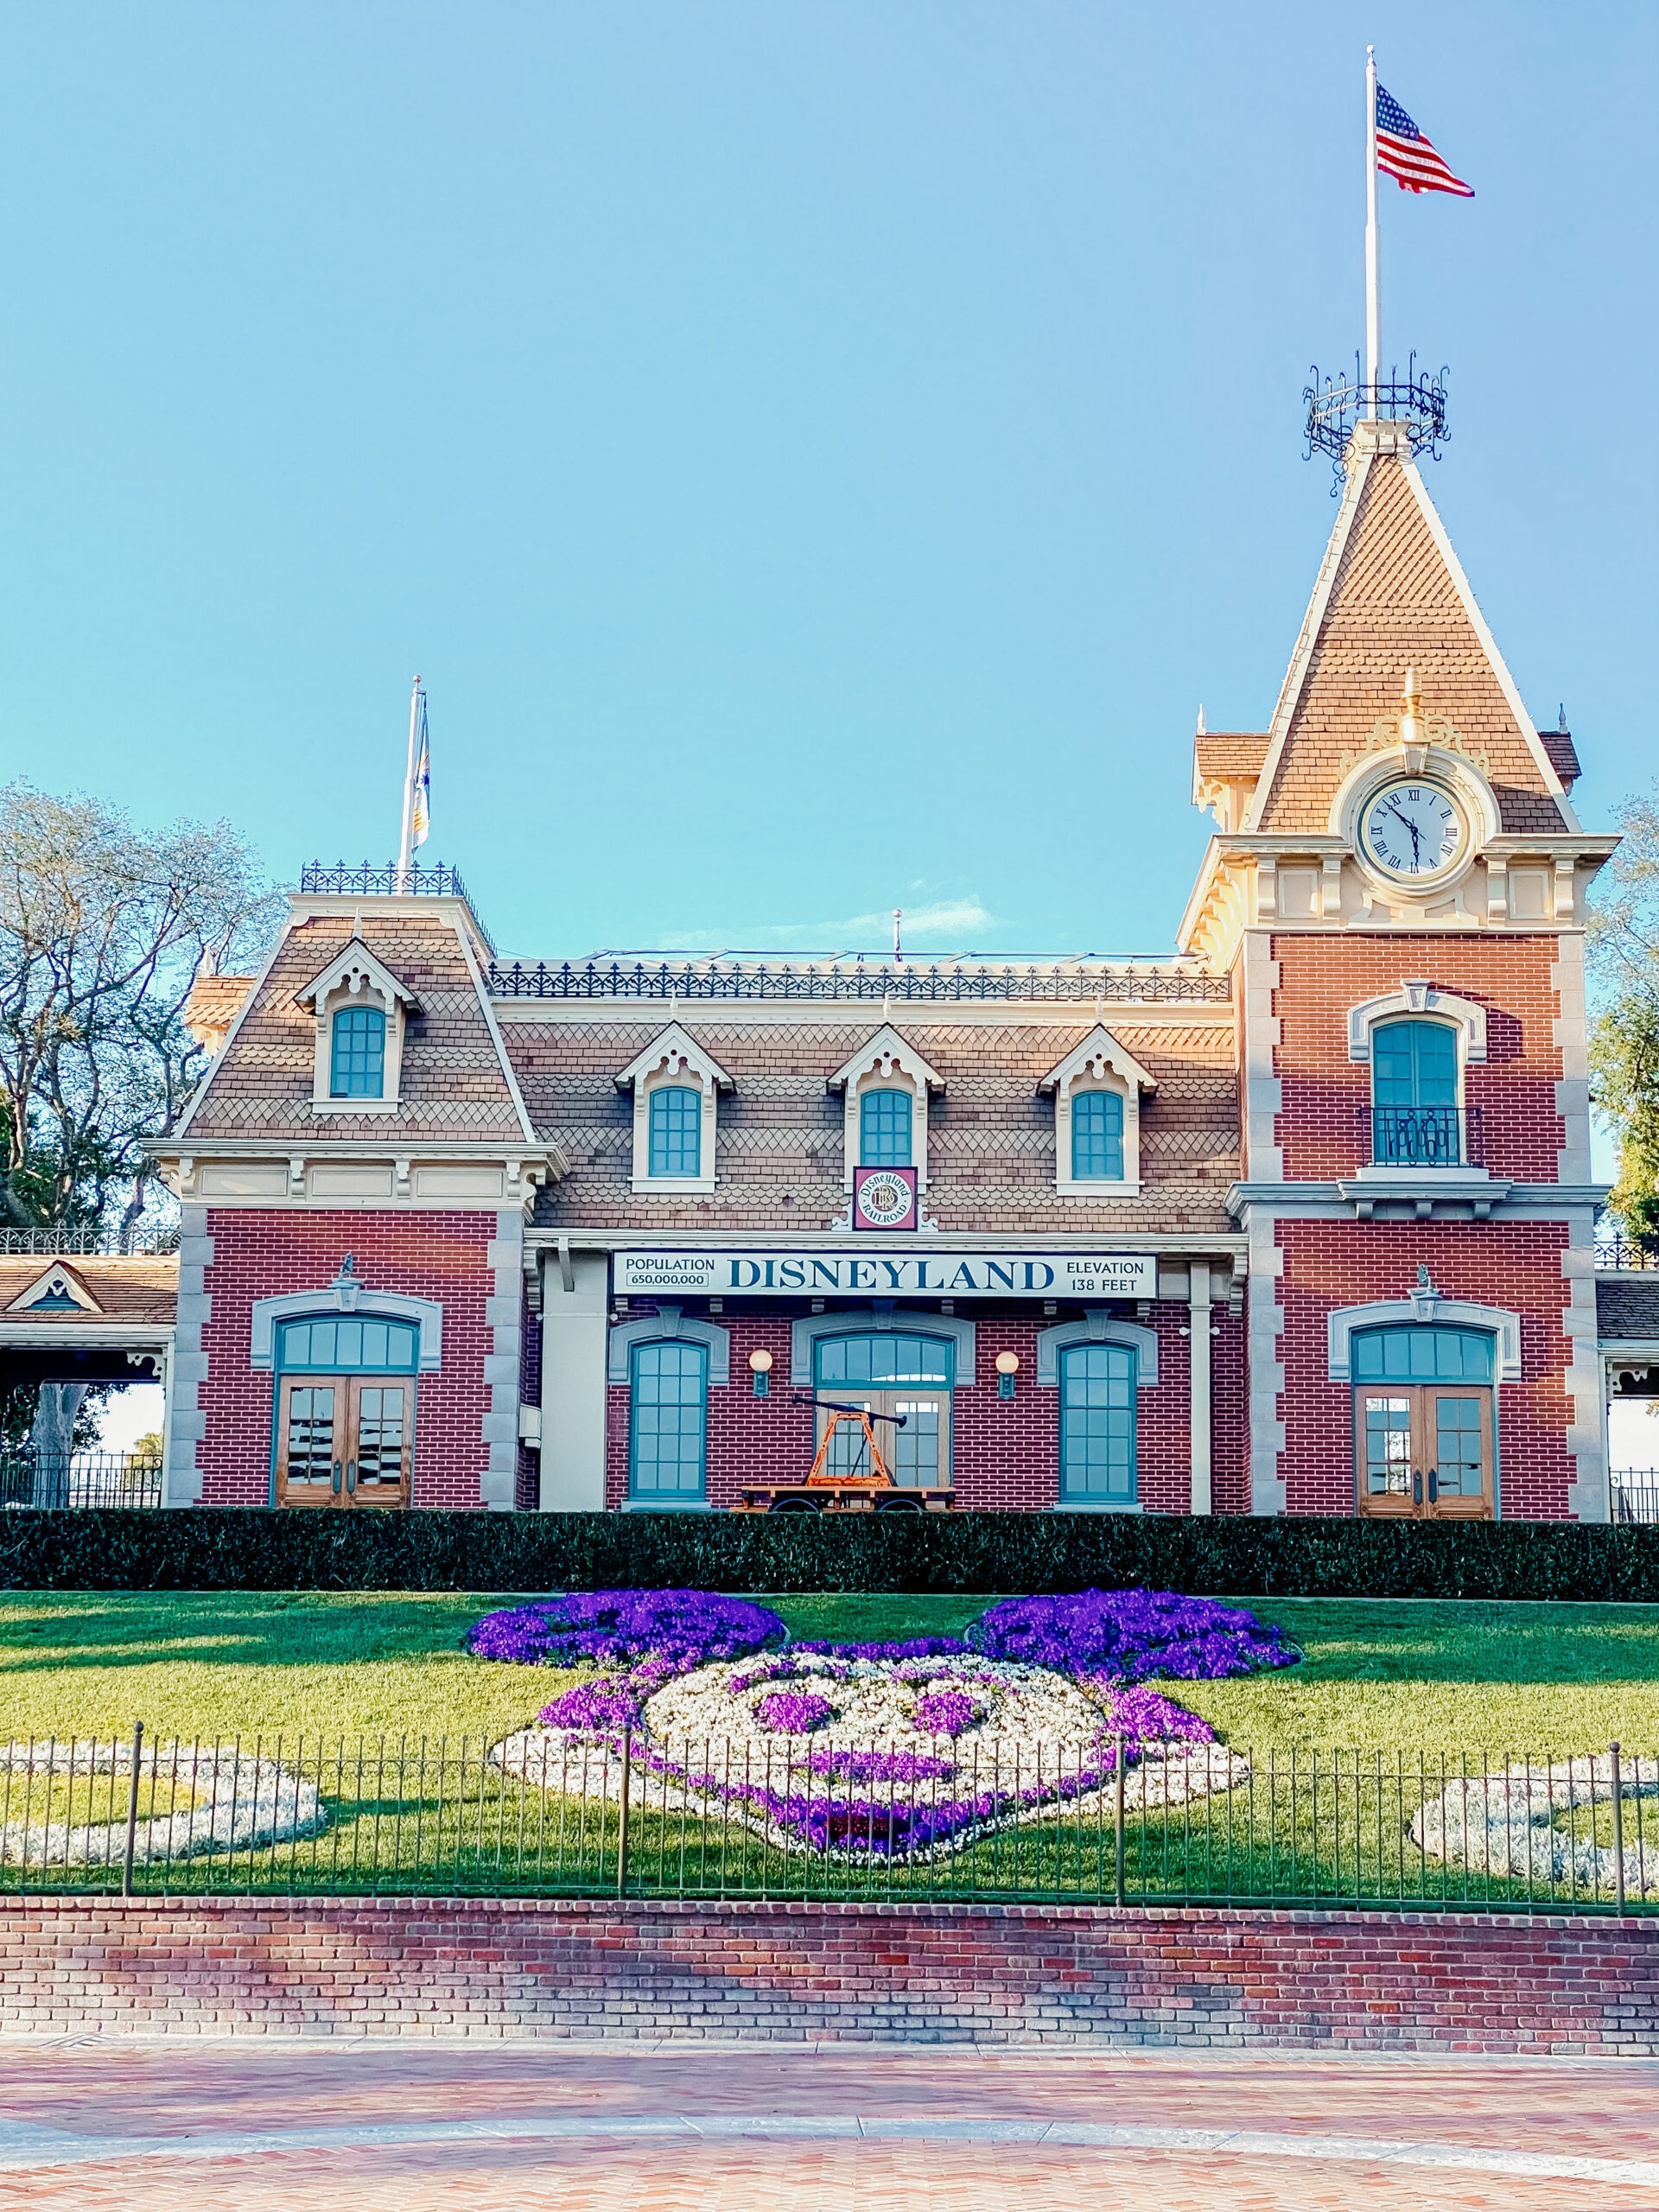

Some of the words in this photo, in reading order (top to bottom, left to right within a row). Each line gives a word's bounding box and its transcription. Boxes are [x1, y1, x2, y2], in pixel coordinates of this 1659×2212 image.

[1389, 793, 1402, 806] XI
[1408, 790, 1420, 801] XII
[1428, 795, 1436, 805] I
[1376, 808, 1388, 818] X
[1440, 809, 1452, 819] II
[1370, 826, 1382, 835] IX
[1446, 828, 1458, 836] III
[1373, 840, 1389, 857] VIII
[1440, 844, 1453, 856] IV
[1388, 855, 1402, 869] VII
[1429, 858, 1438, 869] V
[860, 1174, 911, 1197] Disneyland
[862, 1204, 907, 1223] RAILROAD
[626, 1258, 715, 1270] POPULATION
[1066, 1262, 1143, 1274] ELEVATION
[631, 1274, 704, 1285] 650,000,000
[726, 1259, 1055, 1290] DISNEYLAND
[1071, 1279, 1095, 1291] 138
[1102, 1279, 1137, 1291] FEET
